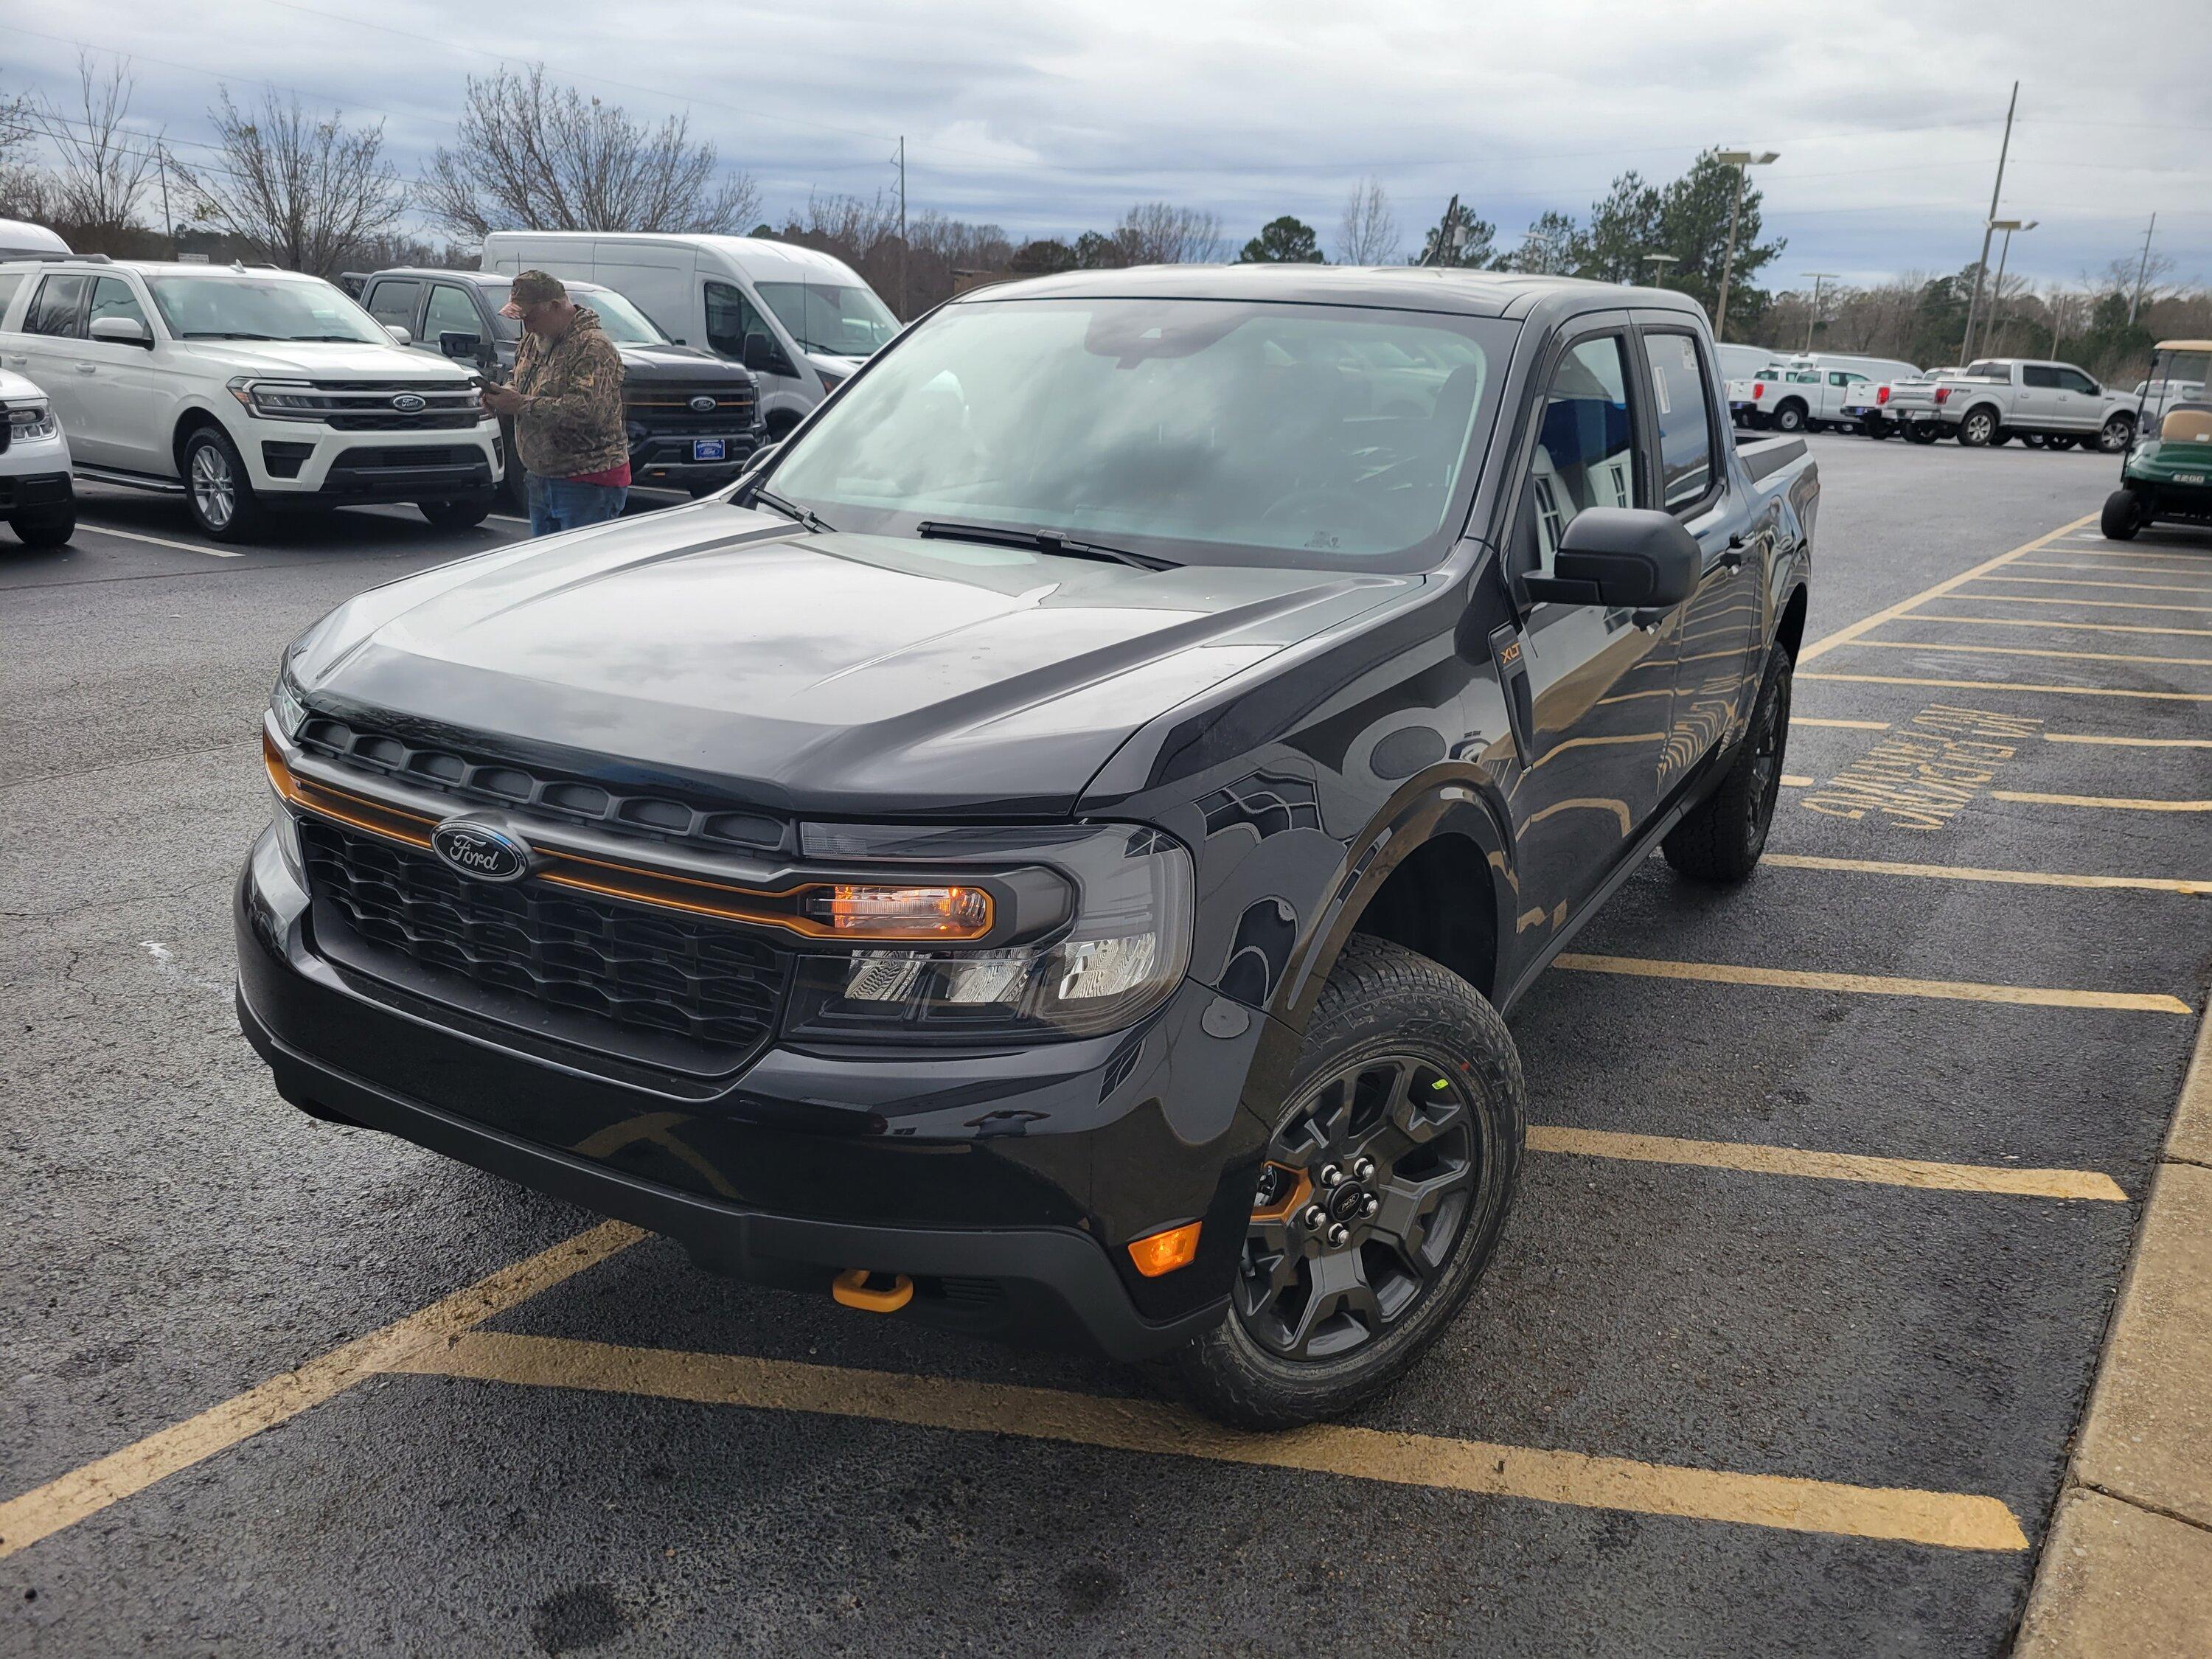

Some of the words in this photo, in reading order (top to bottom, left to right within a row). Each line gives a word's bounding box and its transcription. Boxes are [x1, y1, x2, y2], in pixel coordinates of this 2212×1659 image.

[1500, 642, 1520, 664] XLT
[1800, 730, 2017, 831] PARKING
[450, 834, 499, 871] Ford
